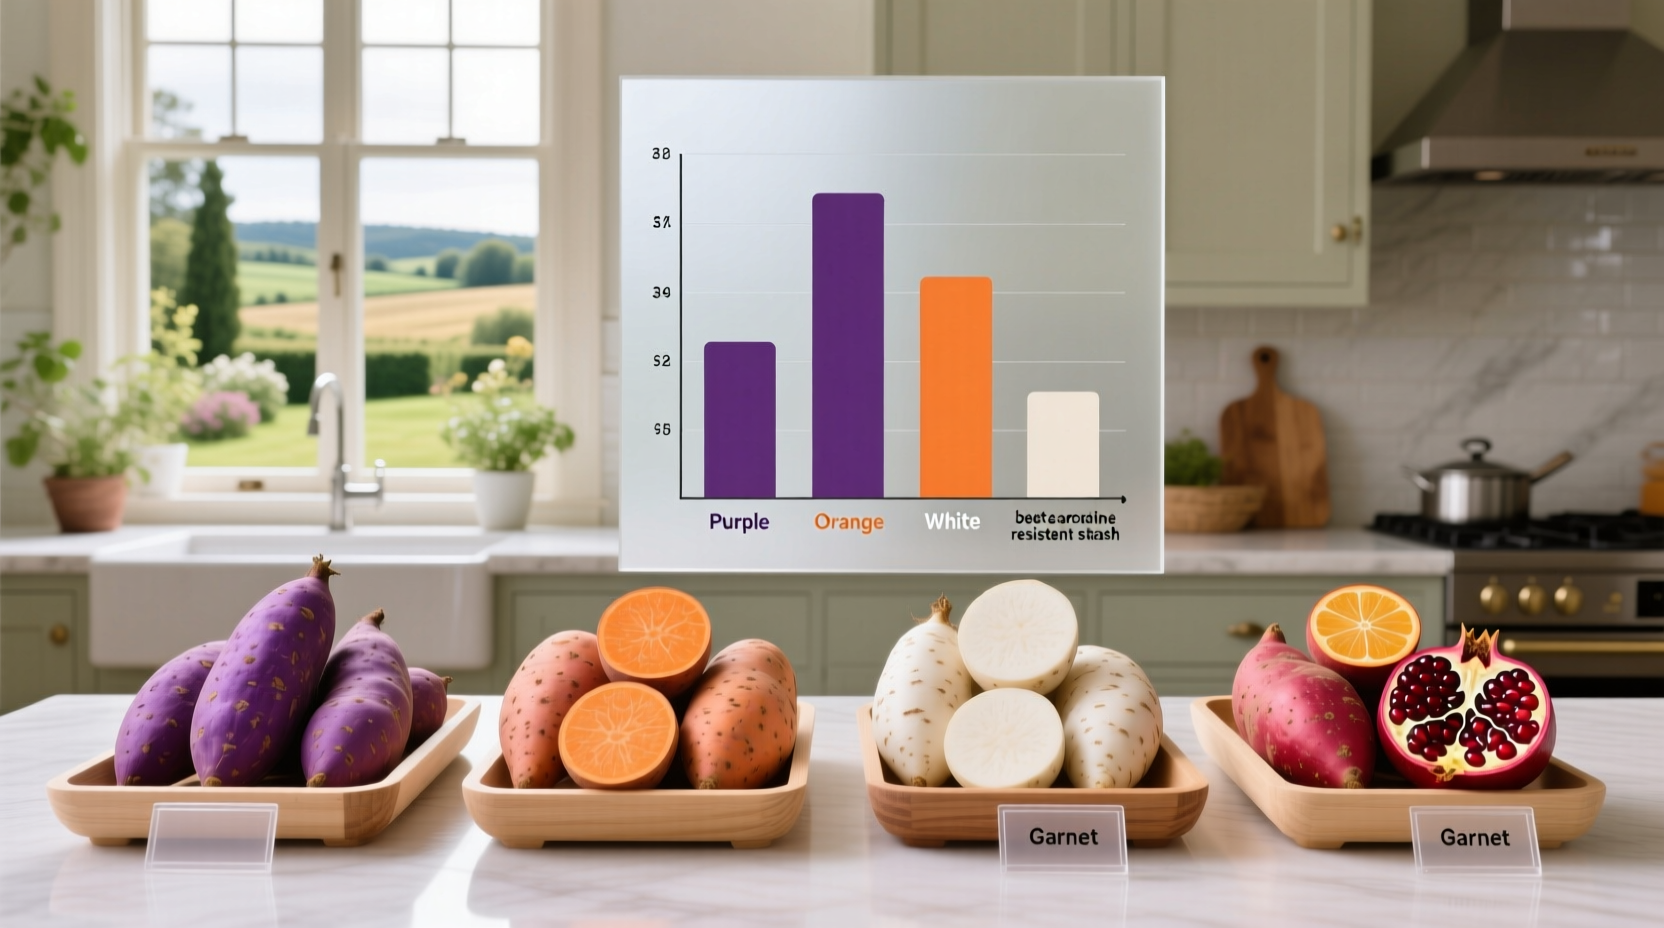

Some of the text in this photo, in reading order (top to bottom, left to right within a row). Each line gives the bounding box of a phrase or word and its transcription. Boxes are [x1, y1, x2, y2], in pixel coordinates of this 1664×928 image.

[710, 512, 770, 535] Purple
[814, 512, 884, 535] Orange
[924, 511, 981, 530] White
[1011, 526, 1074, 541] resistent
[1029, 827, 1099, 846] Garnet
[1440, 827, 1511, 847] Garnet
